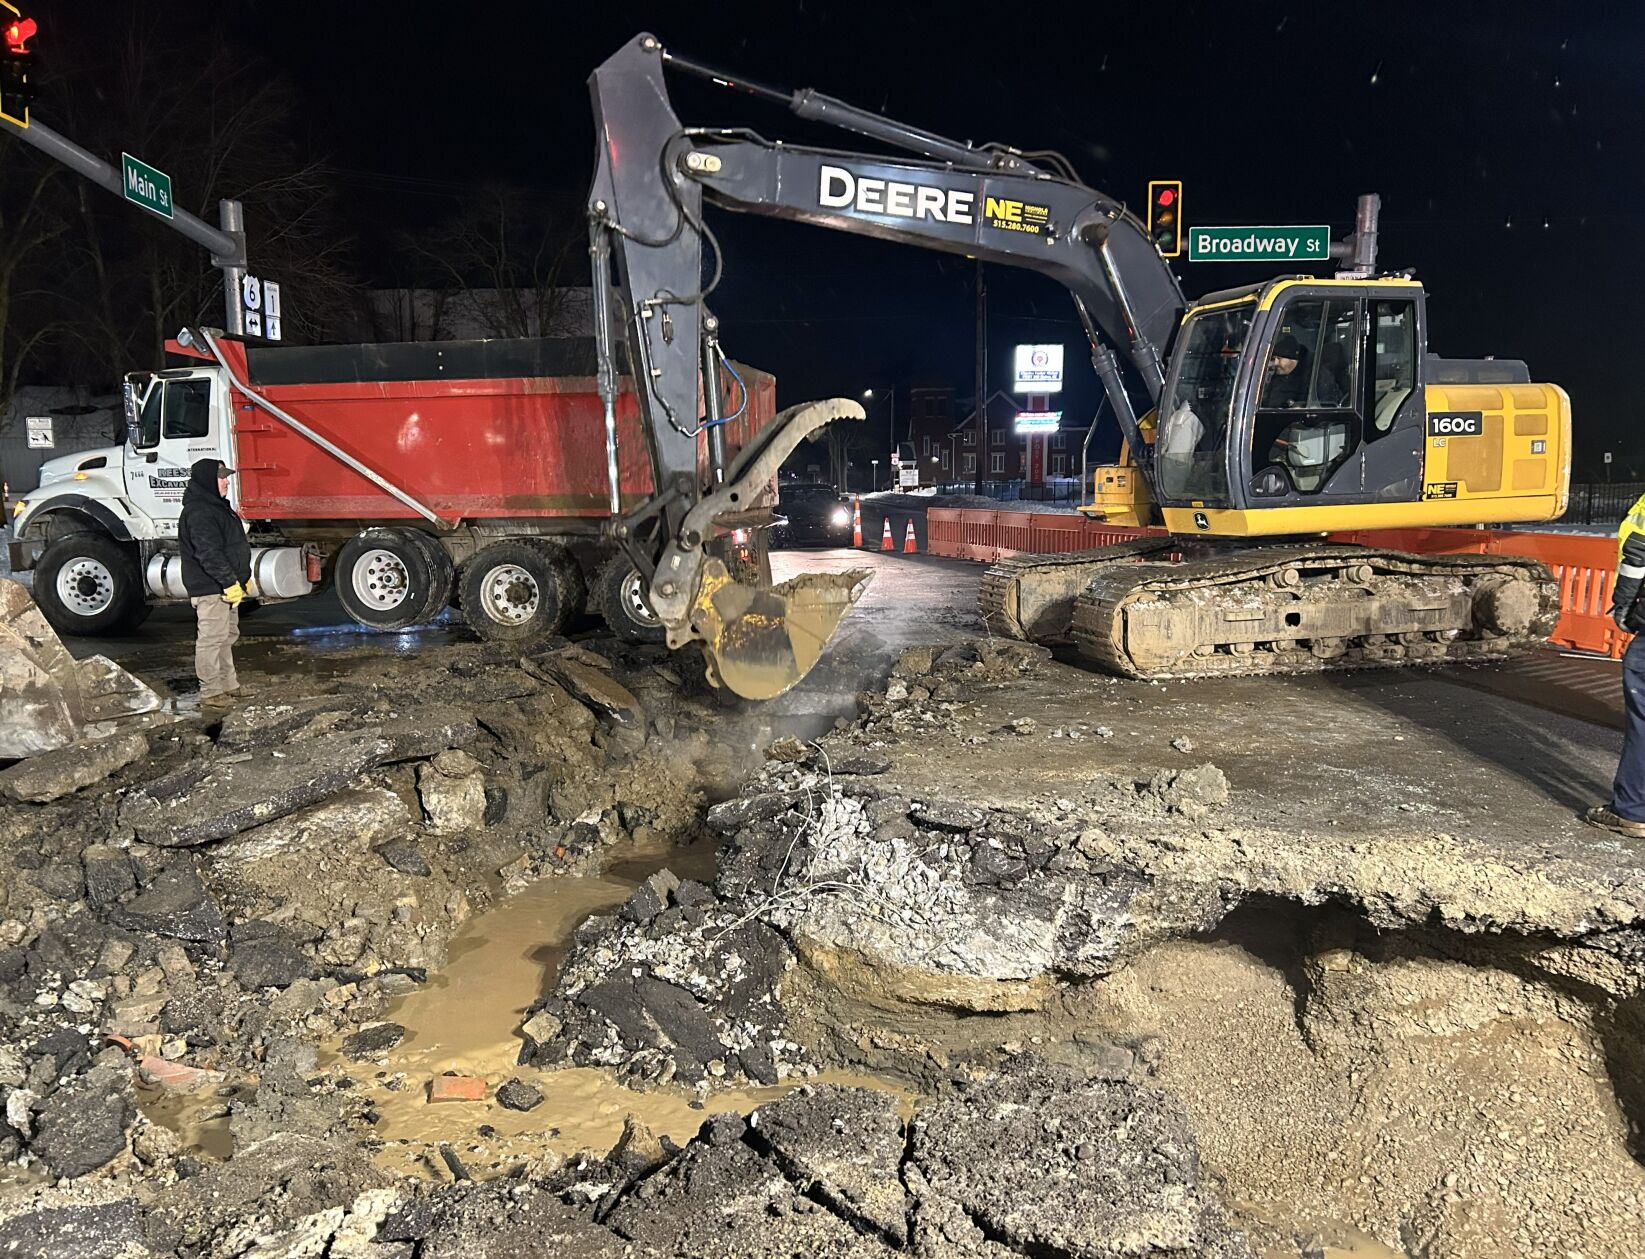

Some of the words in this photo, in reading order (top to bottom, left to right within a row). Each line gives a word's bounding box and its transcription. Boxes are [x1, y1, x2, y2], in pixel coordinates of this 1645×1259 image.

[127, 166, 156, 201] Main
[160, 189, 168, 207] St
[820, 165, 973, 224] DEERE
[985, 197, 1024, 222] NE
[993, 219, 1040, 234] 515.280.7600
[1197, 234, 1300, 257] Broadway
[1306, 239, 1320, 252] St
[250, 284, 255, 301] 6
[1433, 418, 1475, 433] 160G
[1433, 438, 1447, 447] LC
[149, 475, 189, 488] EXCAVAT
[1427, 484, 1445, 495] NE
